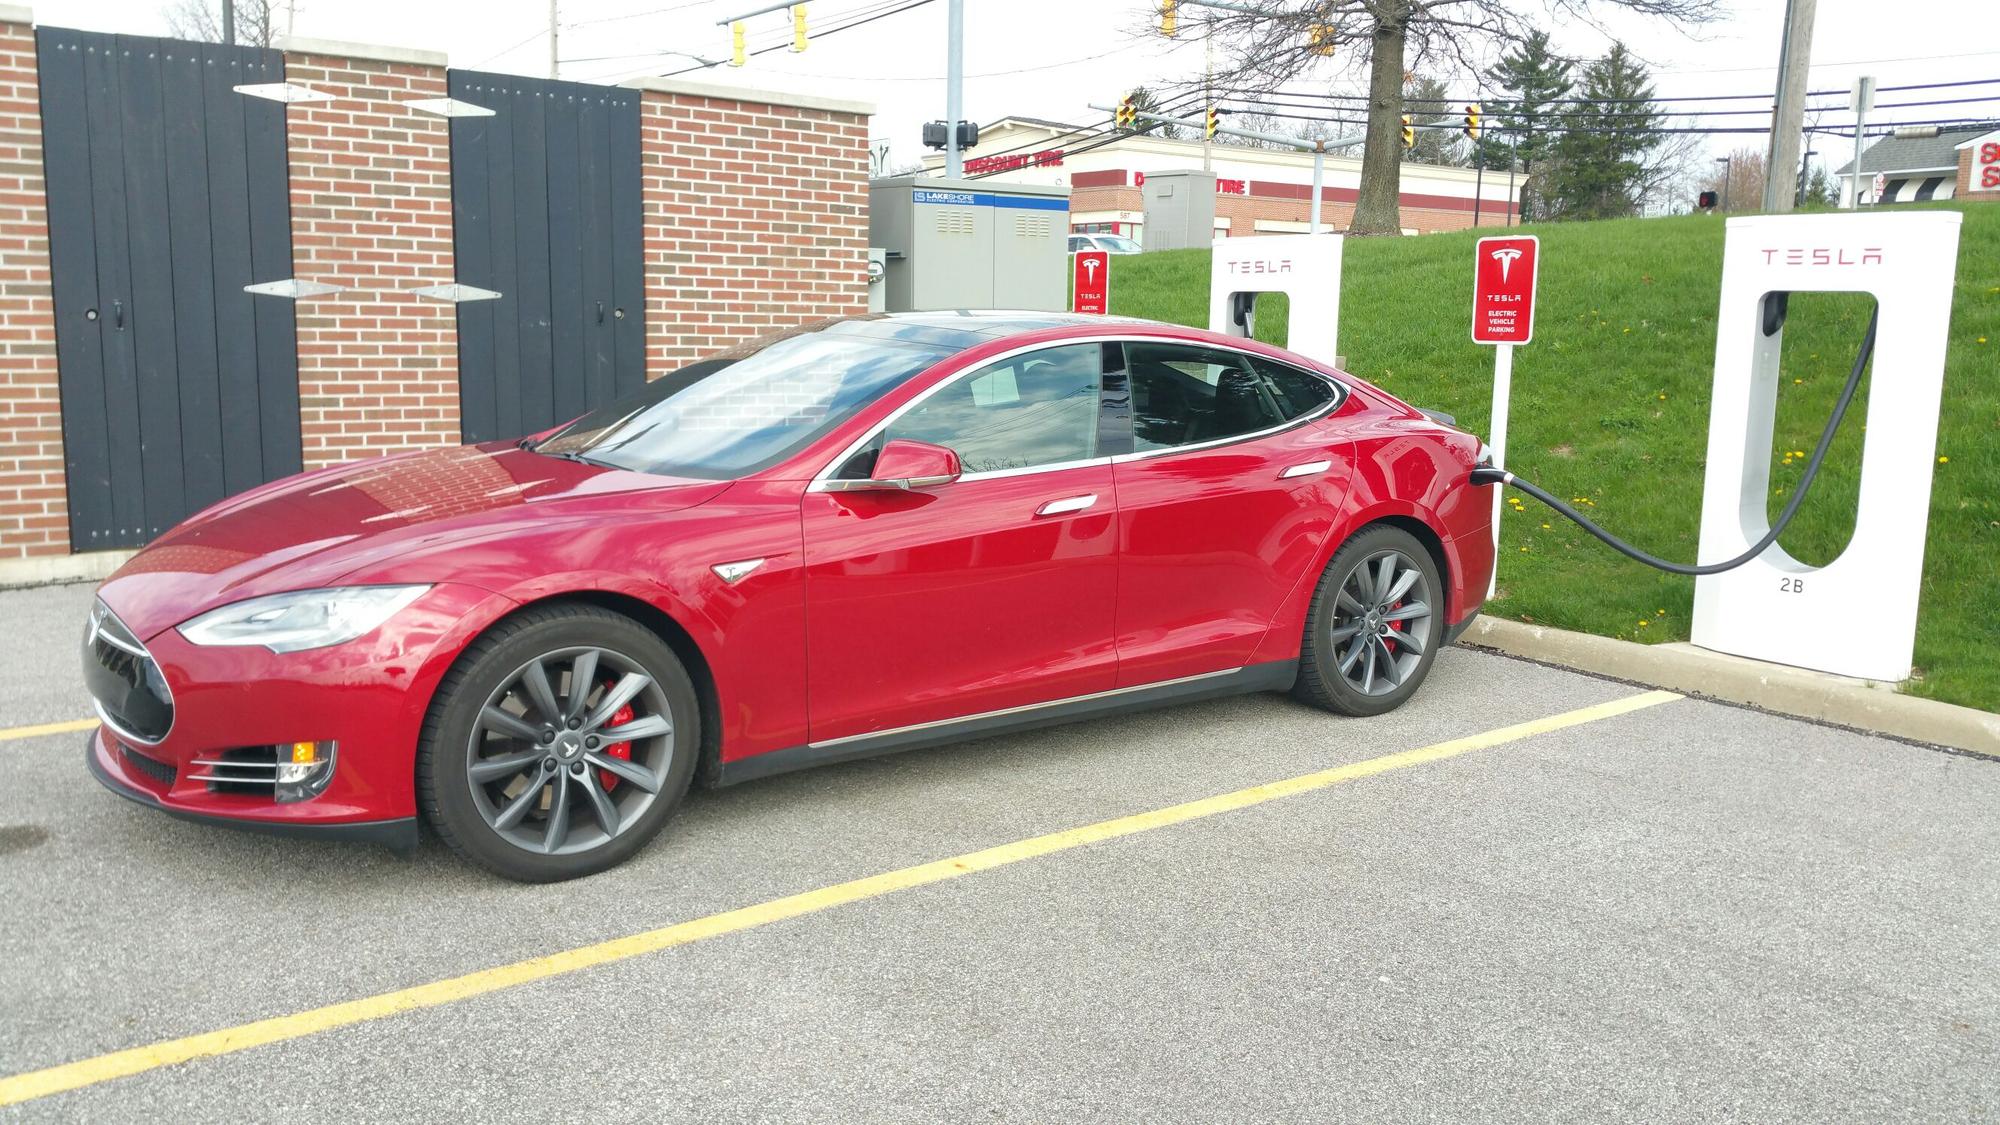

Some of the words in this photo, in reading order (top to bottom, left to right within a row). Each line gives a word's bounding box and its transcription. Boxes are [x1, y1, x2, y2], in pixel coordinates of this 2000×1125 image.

[1034, 149, 1064, 168] TIRE
[1980, 142, 2000, 164] S
[1981, 165, 2000, 188] S
[1216, 178, 1246, 195] TIRE
[926, 192, 975, 201] LAKESHORE
[1761, 248, 1882, 265] TESLA
[1228, 260, 1291, 274] TESLA
[1487, 294, 1521, 302] TESLA
[1780, 577, 1803, 593] 2B
